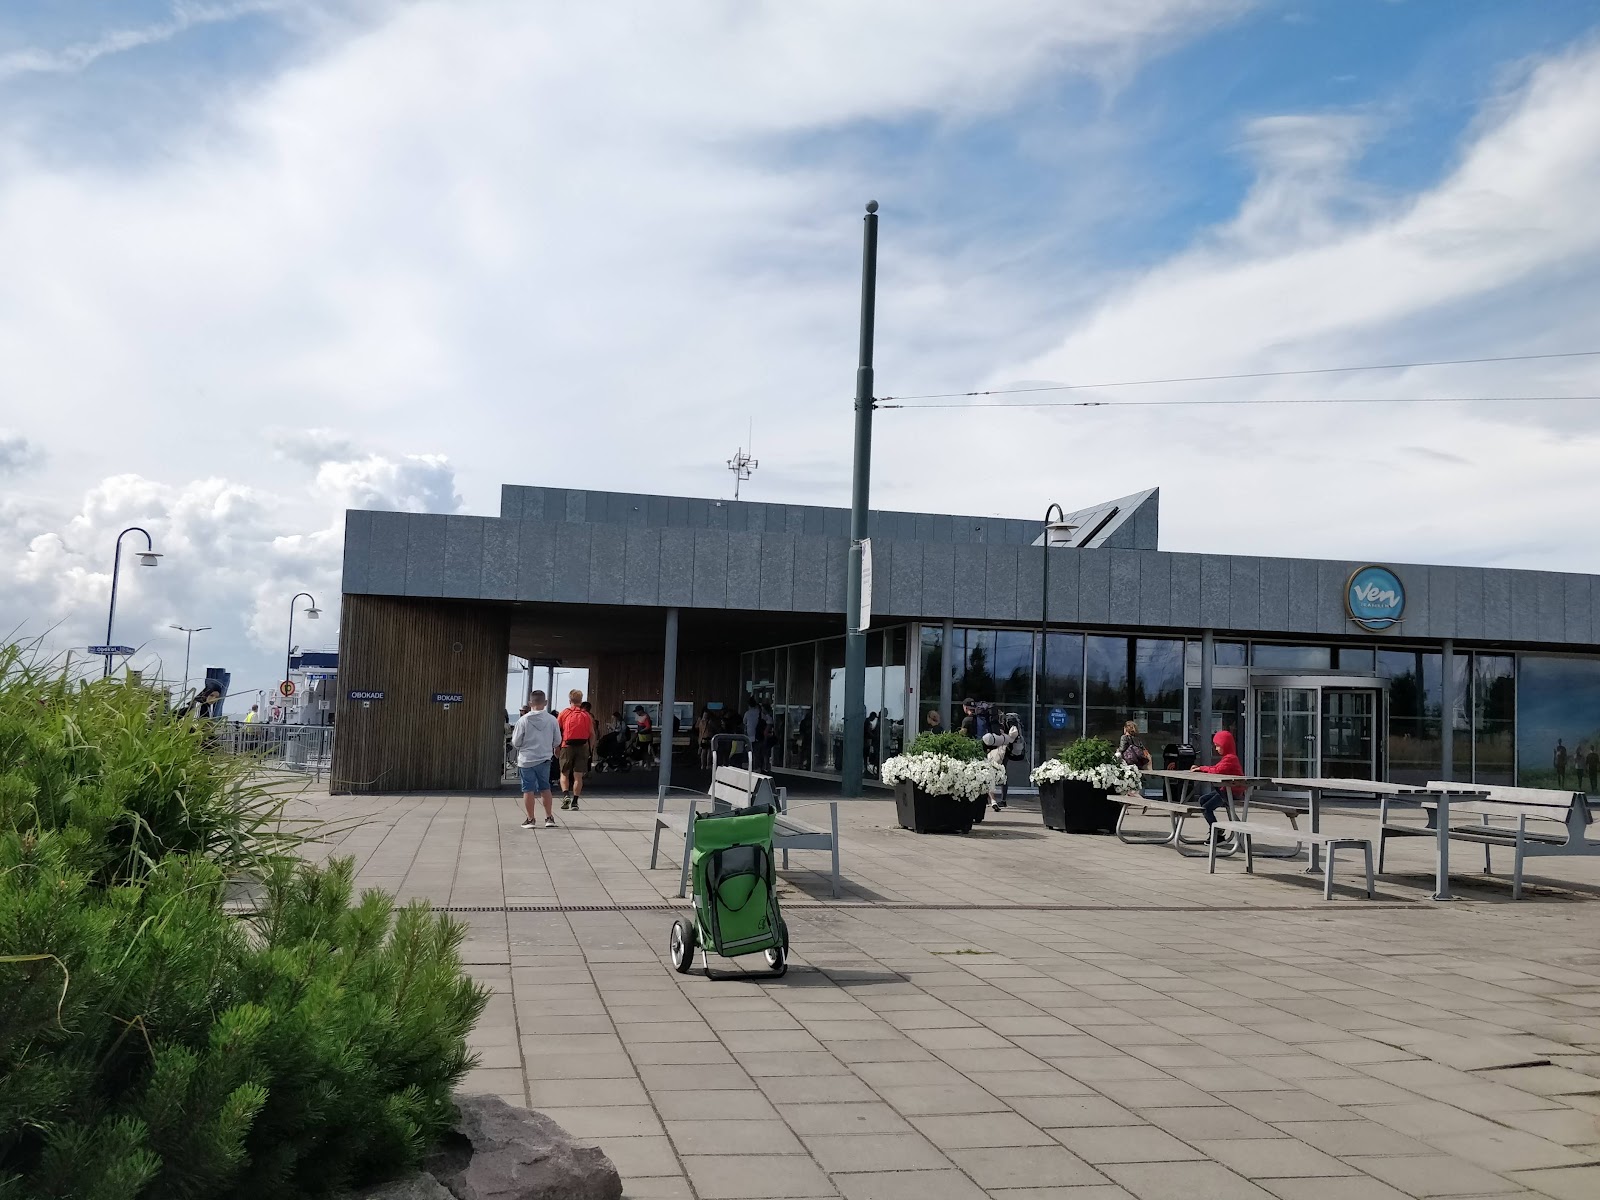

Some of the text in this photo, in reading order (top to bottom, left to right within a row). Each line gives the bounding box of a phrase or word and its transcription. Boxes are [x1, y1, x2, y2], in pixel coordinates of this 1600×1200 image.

[1354, 582, 1401, 608] Ven
[351, 691, 384, 699] OBOKADE
[437, 694, 463, 702] BOKADE
